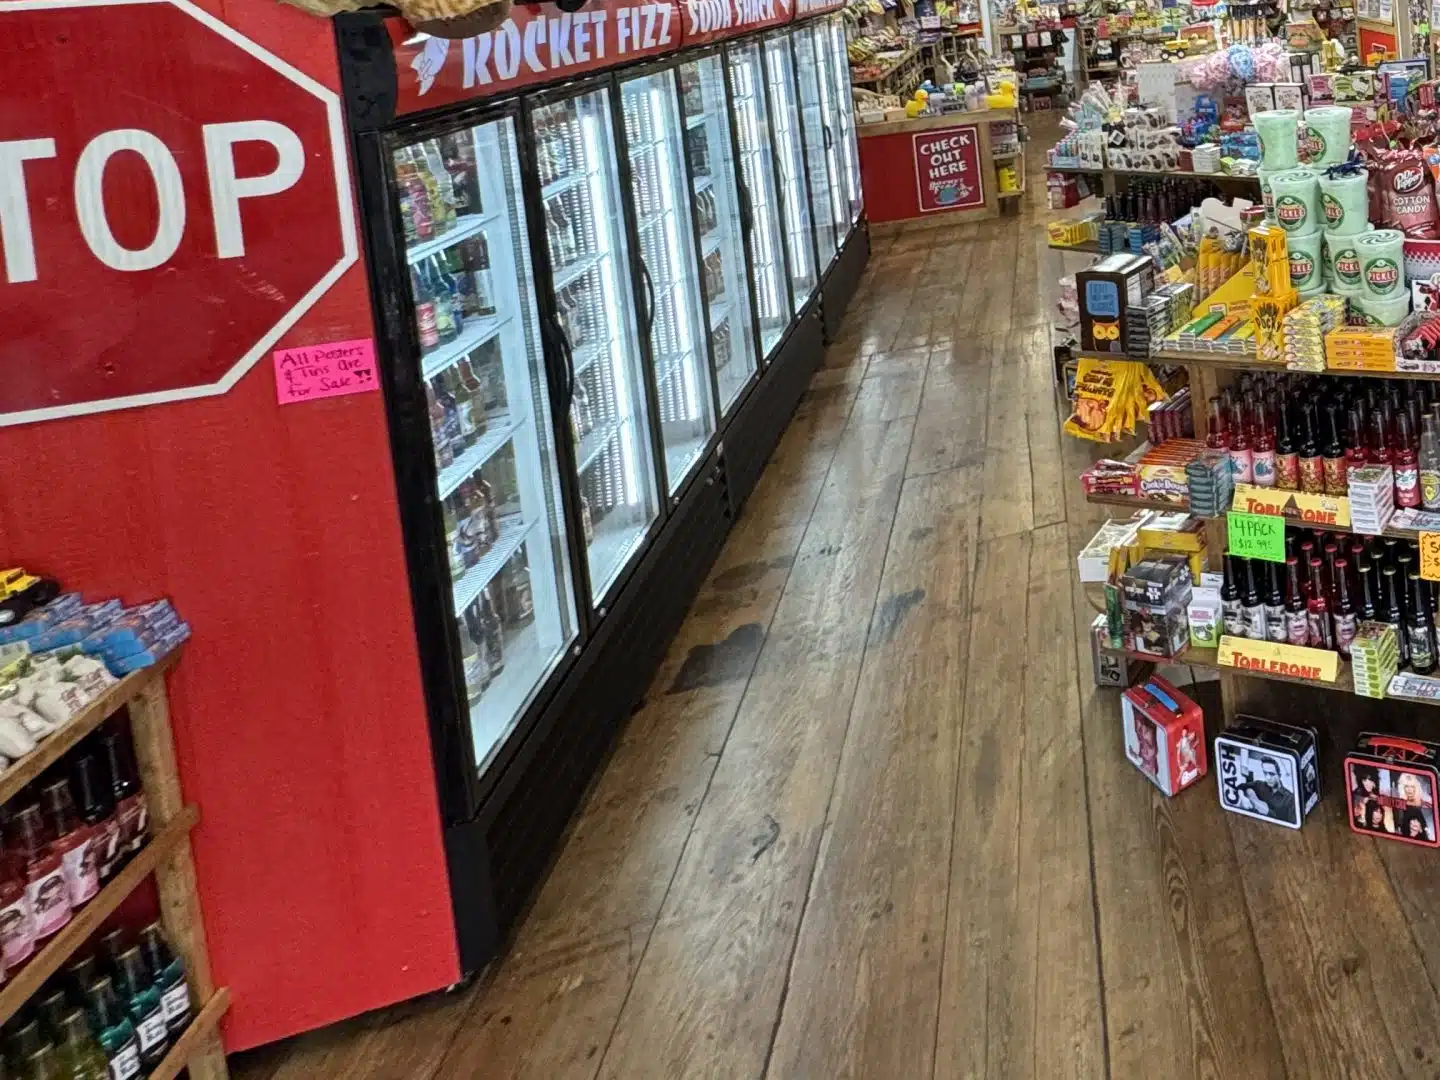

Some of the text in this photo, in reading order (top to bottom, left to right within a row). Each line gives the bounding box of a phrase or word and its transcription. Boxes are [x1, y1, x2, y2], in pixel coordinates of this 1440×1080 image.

[461, 3, 673, 89] ROCKET FIZZ
[920, 134, 970, 155] CHECK
[930, 149, 961, 166] OUT
[929, 160, 968, 179] HERE
[0, 120, 306, 284] TOP
[1393, 195, 1430, 206] COTTON
[1397, 204, 1428, 215] CANDY
[1368, 271, 1398, 281] PICKLE
[1243, 520, 1277, 537] PACK
[1231, 651, 1323, 680] TOBLERONE
[1221, 744, 1240, 805] CASH
